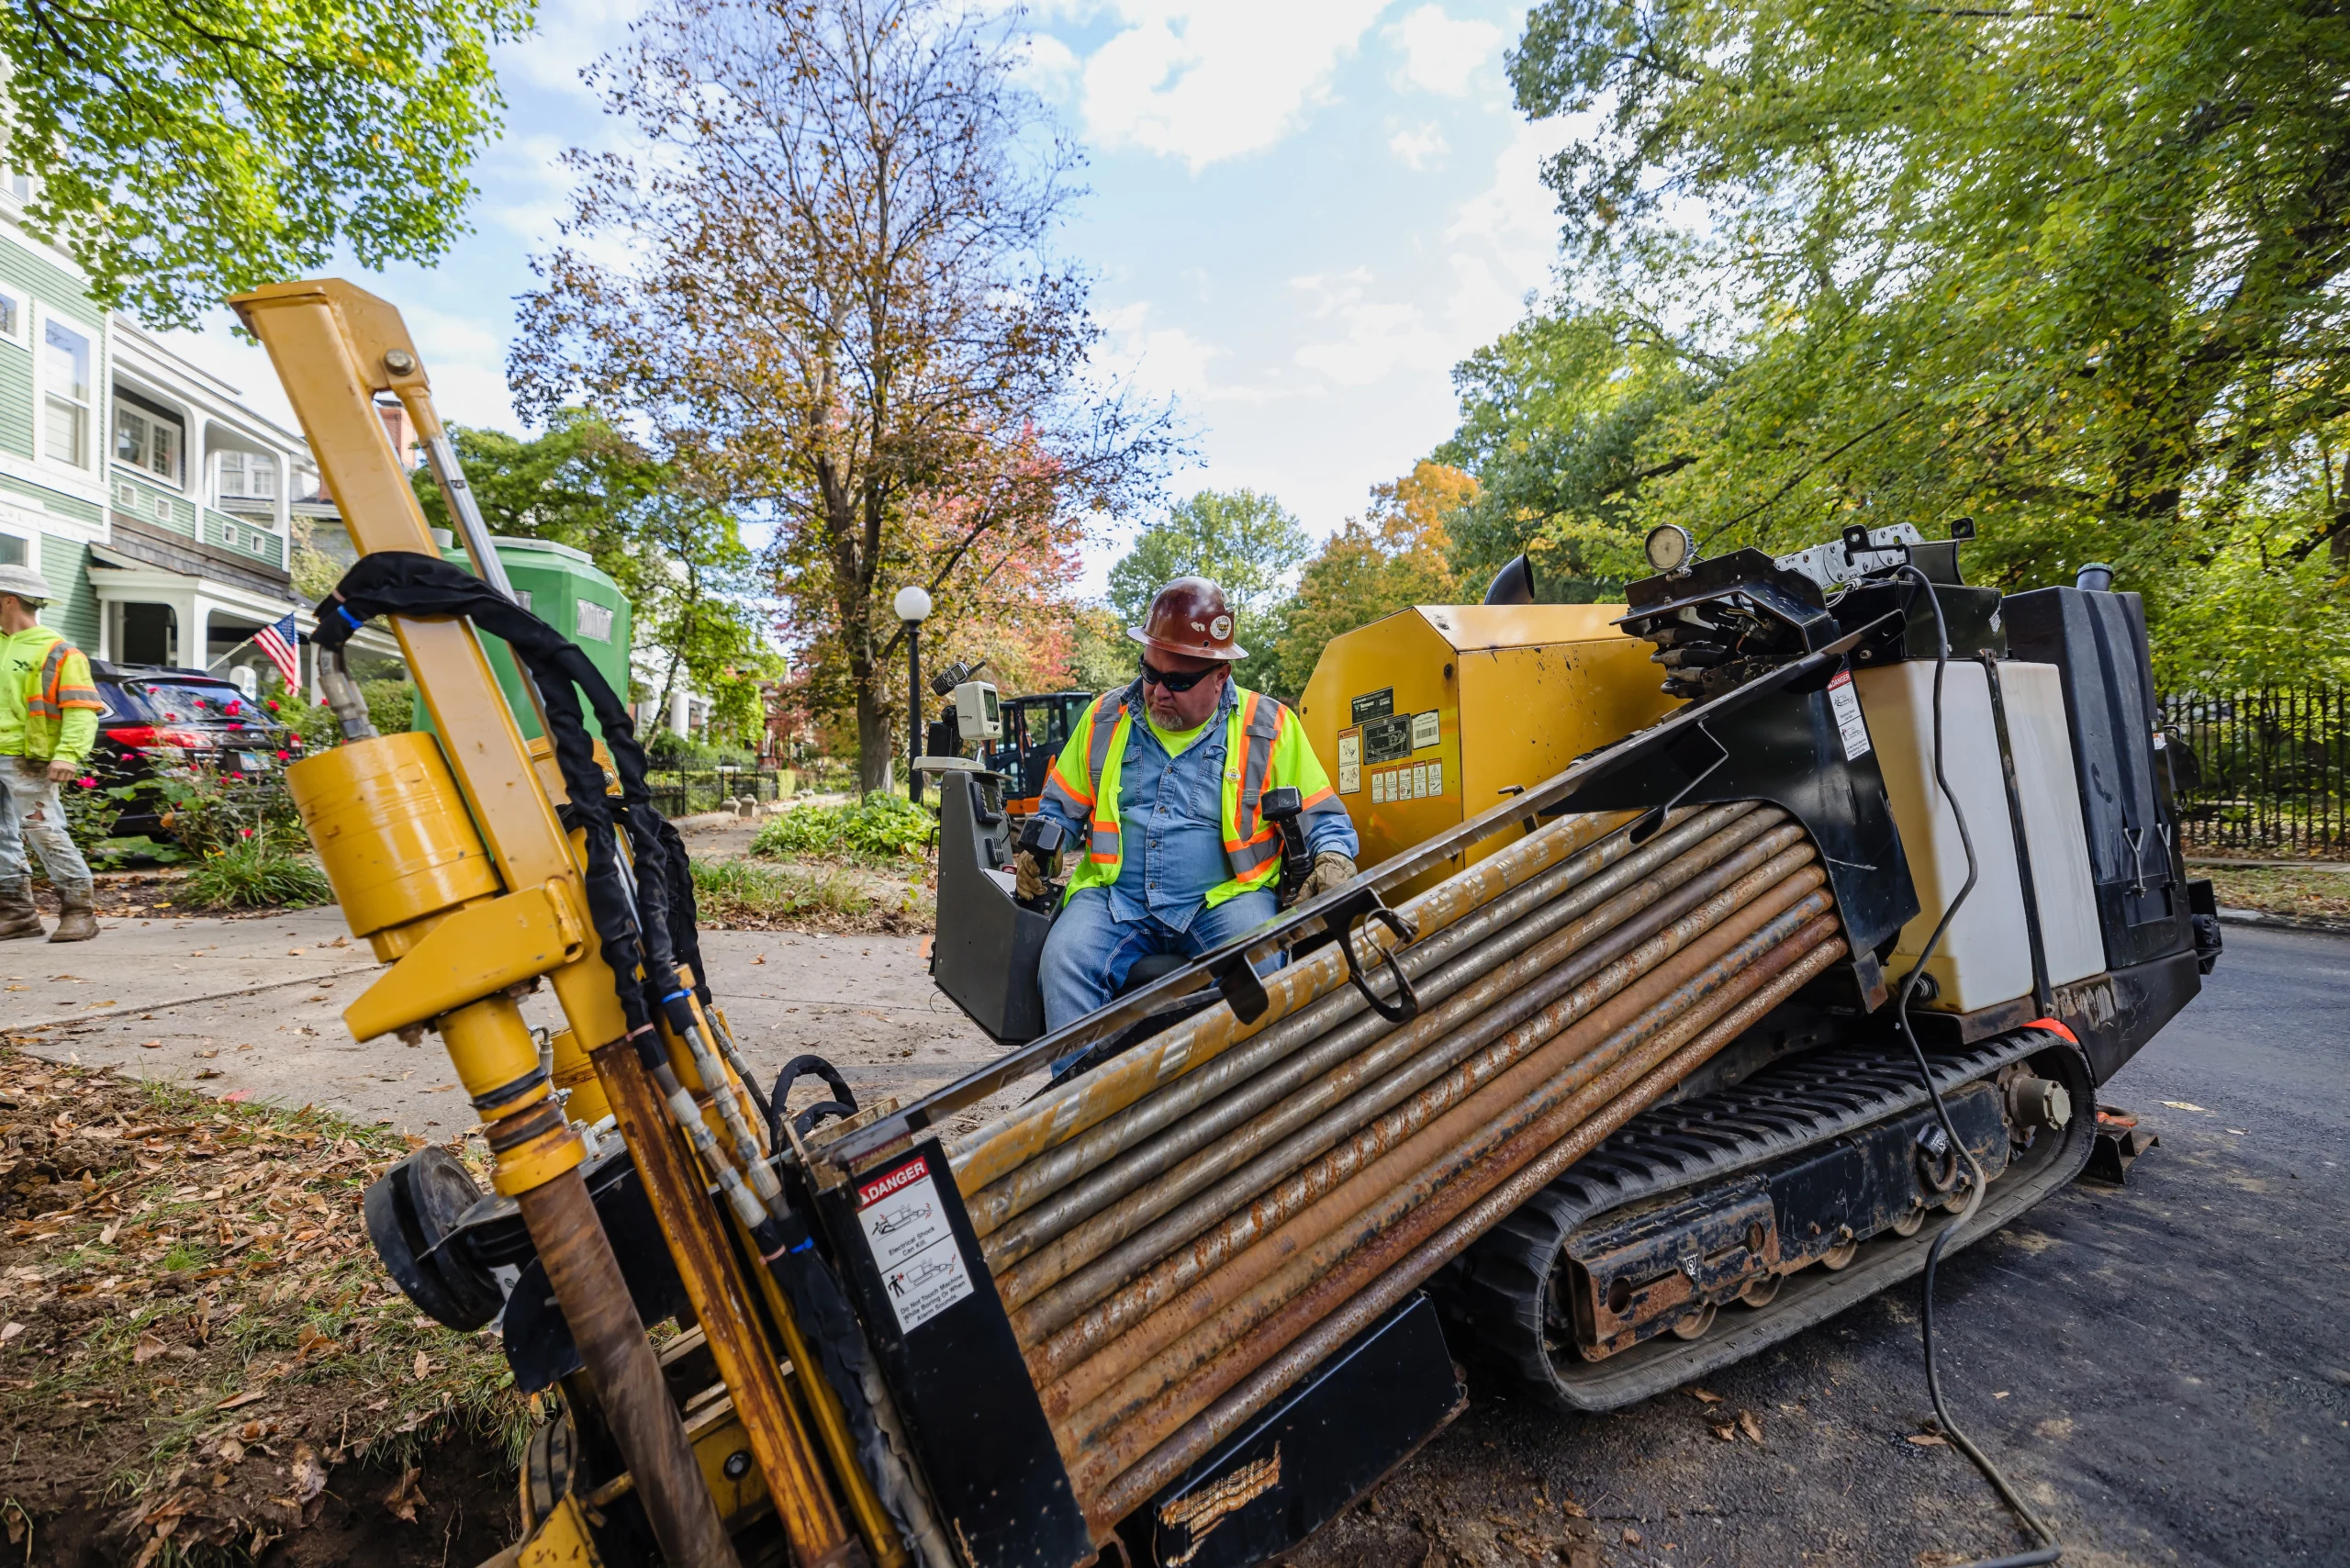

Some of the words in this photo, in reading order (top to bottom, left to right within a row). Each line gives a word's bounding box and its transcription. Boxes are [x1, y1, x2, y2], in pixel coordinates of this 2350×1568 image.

[1832, 674, 1850, 687] DANGER
[869, 1161, 925, 1200] DANGER
[889, 1236, 916, 1256] Electrical
[916, 1226, 934, 1239] Shock
[902, 1247, 913, 1256] Can
[915, 1240, 927, 1249] Kill.
[901, 1305, 910, 1315] Do
[910, 1299, 922, 1310] Not
[922, 1289, 939, 1305] Touch
[939, 1273, 963, 1291] Machine
[903, 1307, 921, 1321] While
[921, 1296, 941, 1315] Boring
[941, 1289, 949, 1299] Or
[949, 1282, 966, 1294] When
[916, 1307, 934, 1322] Alarm
[934, 1294, 958, 1310] Sounds.
